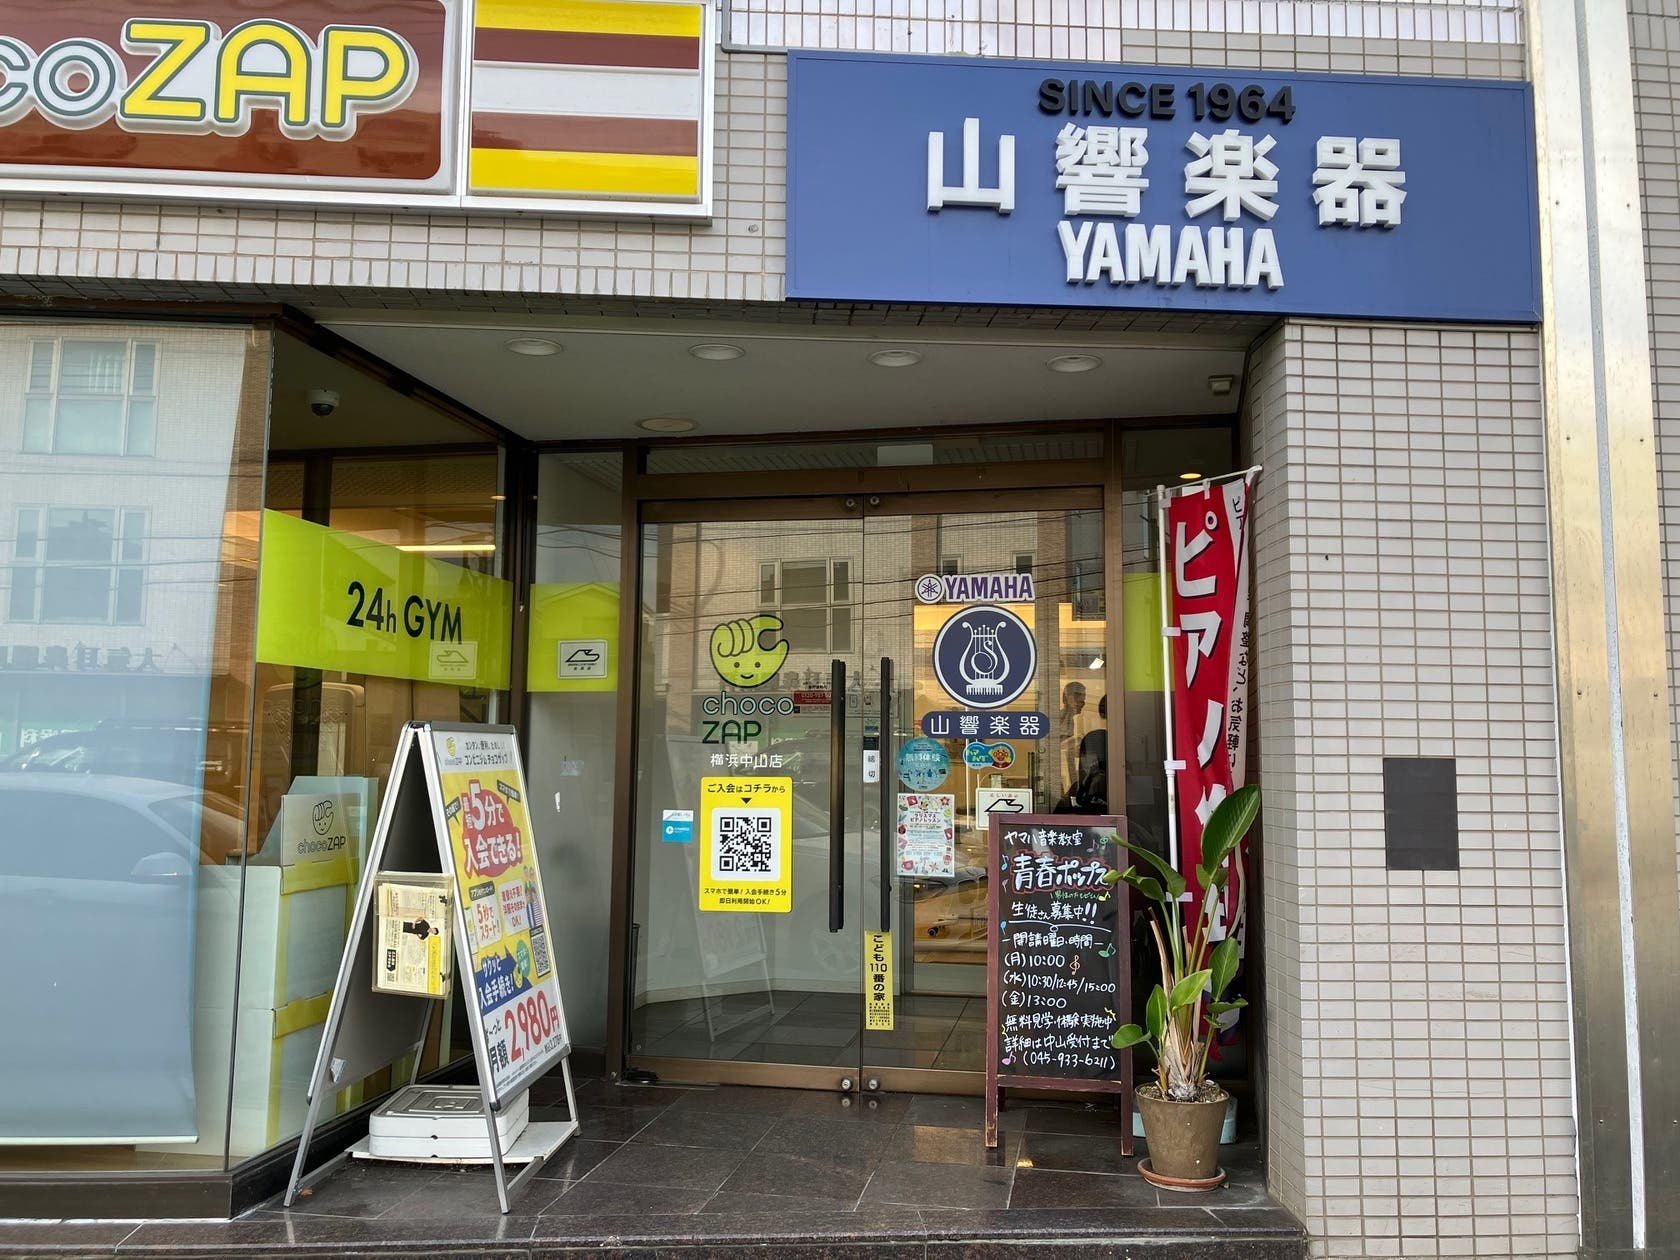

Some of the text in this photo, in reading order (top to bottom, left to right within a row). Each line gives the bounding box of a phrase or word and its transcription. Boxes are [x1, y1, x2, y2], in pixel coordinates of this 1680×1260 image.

[1039, 78, 1297, 122] SINCE 1964
[927, 117, 1406, 228] 山響楽器
[1058, 220, 1285, 289] YAMAHA
[945, 575, 1033, 600] YAMAHA
[346, 581, 462, 644] 24h GYM
[702, 691, 794, 716] choco
[702, 721, 762, 744] ZAP
[930, 715, 1040, 735] 山響楽器
[710, 753, 784, 769] 横浜中山店
[708, 784, 786, 793] ご入会はコチラから
[1004, 829, 1083, 846] ヤマハ音楽教室
[464, 832, 521, 873] 入会できる!
[1013, 853, 1109, 890] 青春ポップス
[1011, 901, 1097, 925] 生徒さん募集中!!
[870, 934, 888, 1001] こども110番の家
[1004, 1032, 1114, 1053] 詳細は中山受付まで
